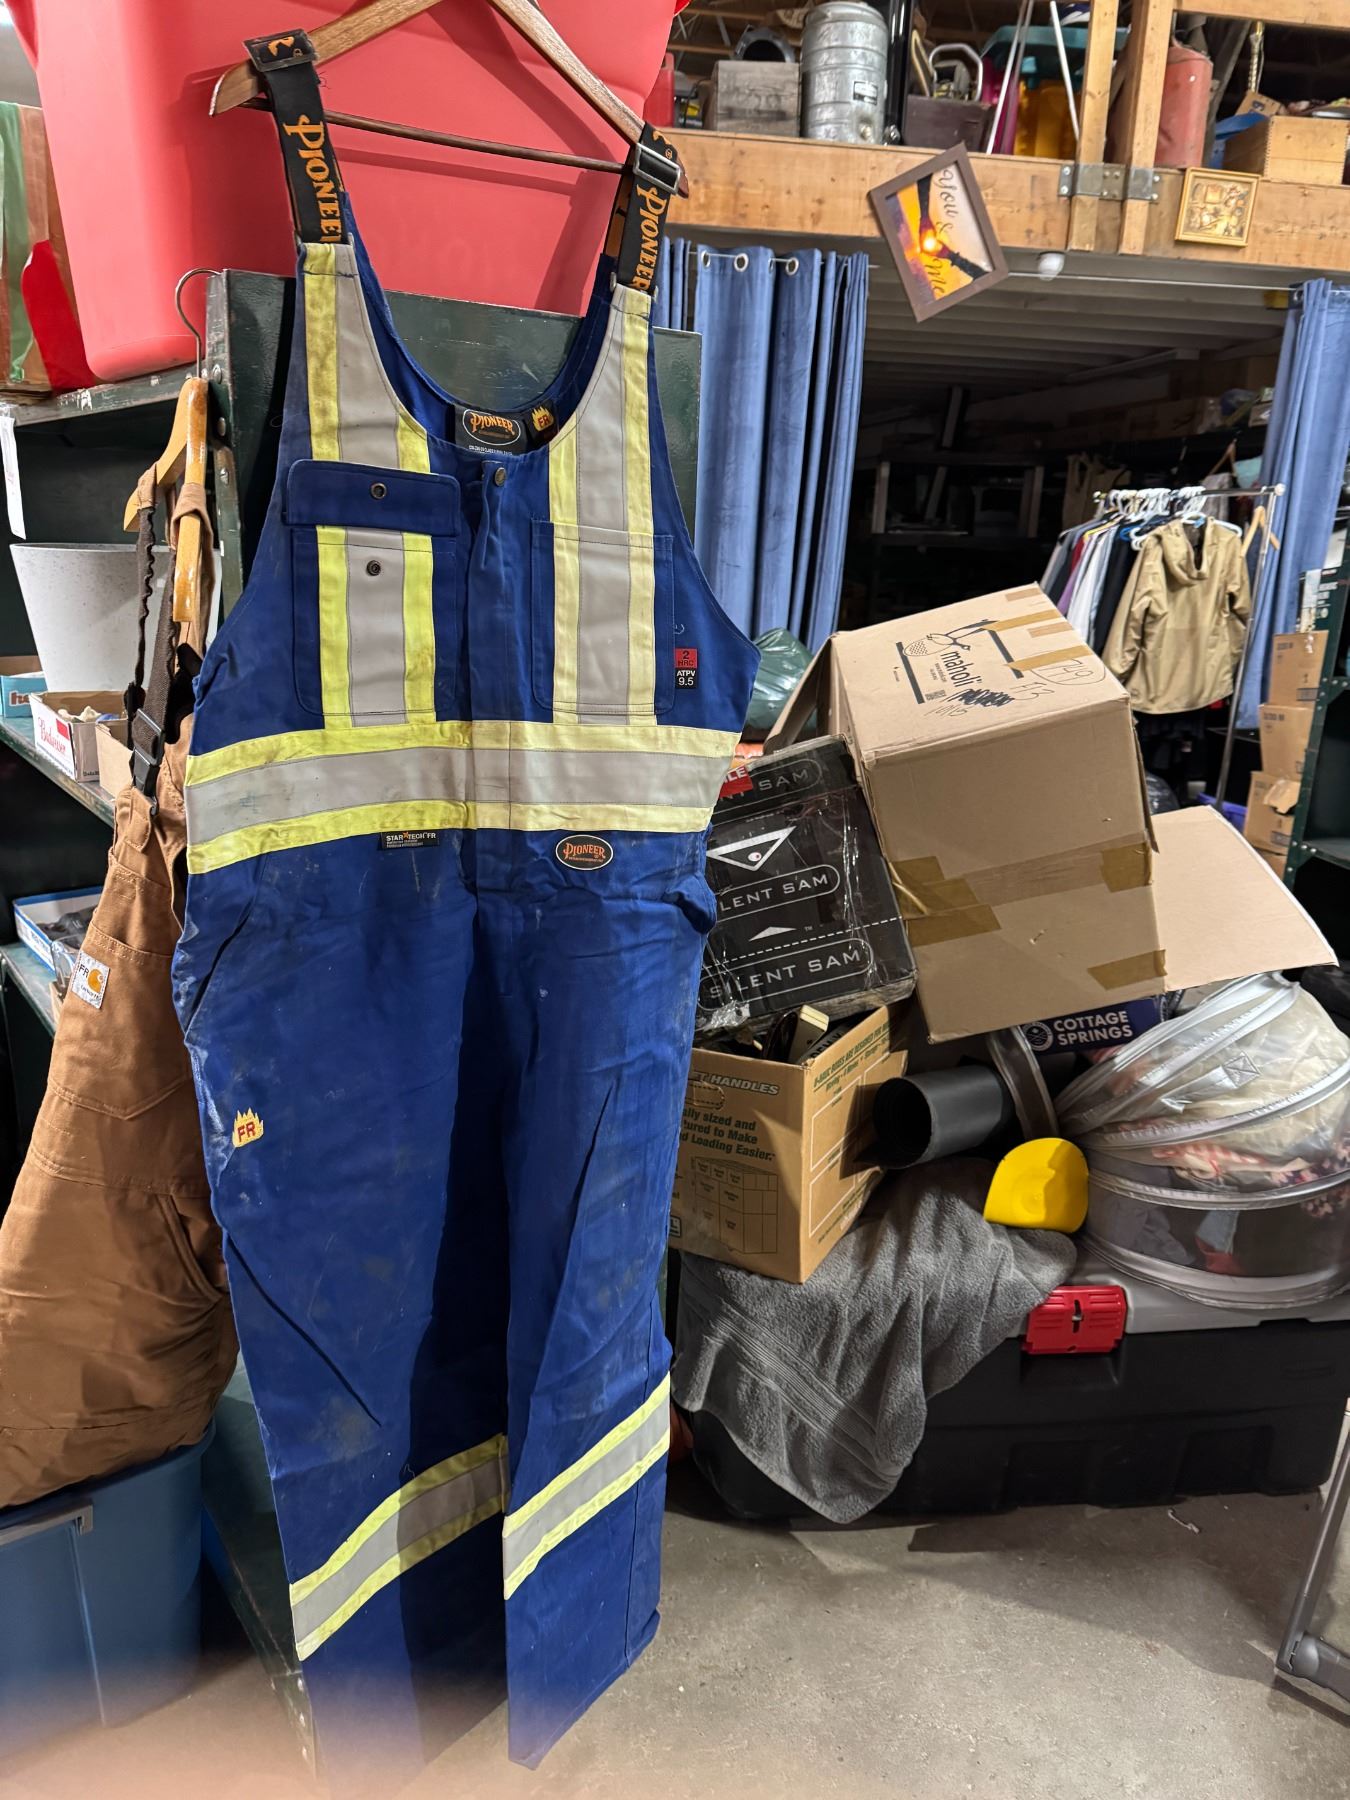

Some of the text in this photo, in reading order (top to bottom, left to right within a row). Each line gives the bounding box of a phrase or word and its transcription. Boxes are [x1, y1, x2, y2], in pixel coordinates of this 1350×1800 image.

[283, 114, 342, 243] PIONEE
[933, 169, 958, 218] You
[633, 184, 667, 291] PIONEER
[924, 258, 946, 294] Me
[469, 411, 516, 436] PIONEER
[537, 415, 550, 428] FR
[677, 659, 694, 667] HRC
[682, 650, 690, 660] 2
[940, 650, 982, 687] maholi
[678, 676, 694, 686] 9.5
[724, 766, 748, 783] LE
[758, 768, 810, 791] SAM
[386, 834, 404, 842] STAR
[562, 842, 607, 860] PIONEER
[719, 874, 829, 912] LENT SAM
[79, 963, 90, 979] FR
[807, 949, 861, 973] SAM
[1053, 1010, 1129, 1032] COTTAGE
[1057, 1025, 1133, 1046] SPRINGS
[709, 1075, 780, 1096] HANDLES
[237, 1121, 257, 1143] FR
[702, 1112, 733, 1126] sized
[735, 1119, 757, 1132] and
[692, 1135, 733, 1154] Loading
[714, 1125, 725, 1138] to
[728, 1129, 758, 1145] Make
